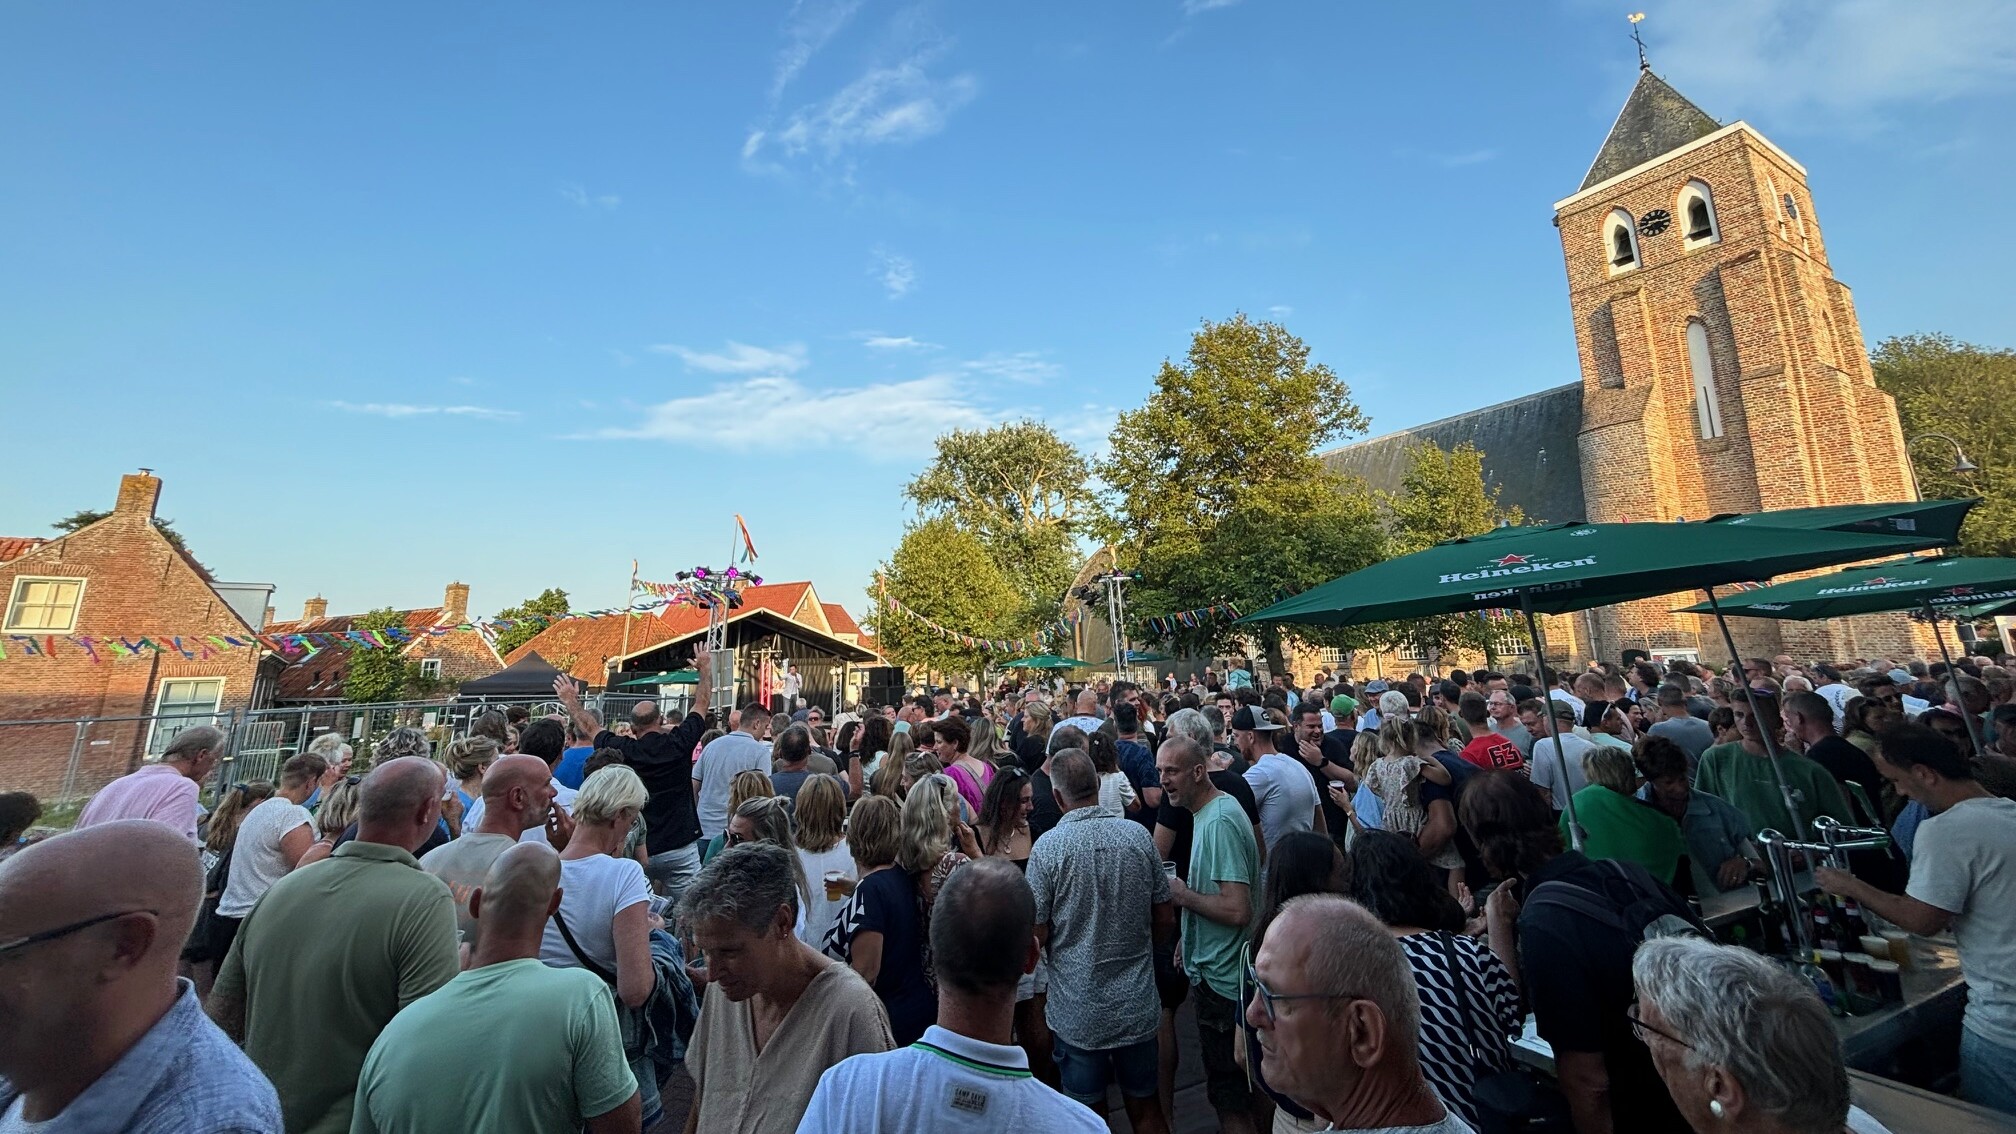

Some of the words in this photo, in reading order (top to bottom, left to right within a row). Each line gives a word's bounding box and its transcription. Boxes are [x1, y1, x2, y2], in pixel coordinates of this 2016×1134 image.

[1438, 556, 1597, 584] Heineken
[1817, 579, 1929, 595] Heineken
[1487, 741, 1520, 768] 63
